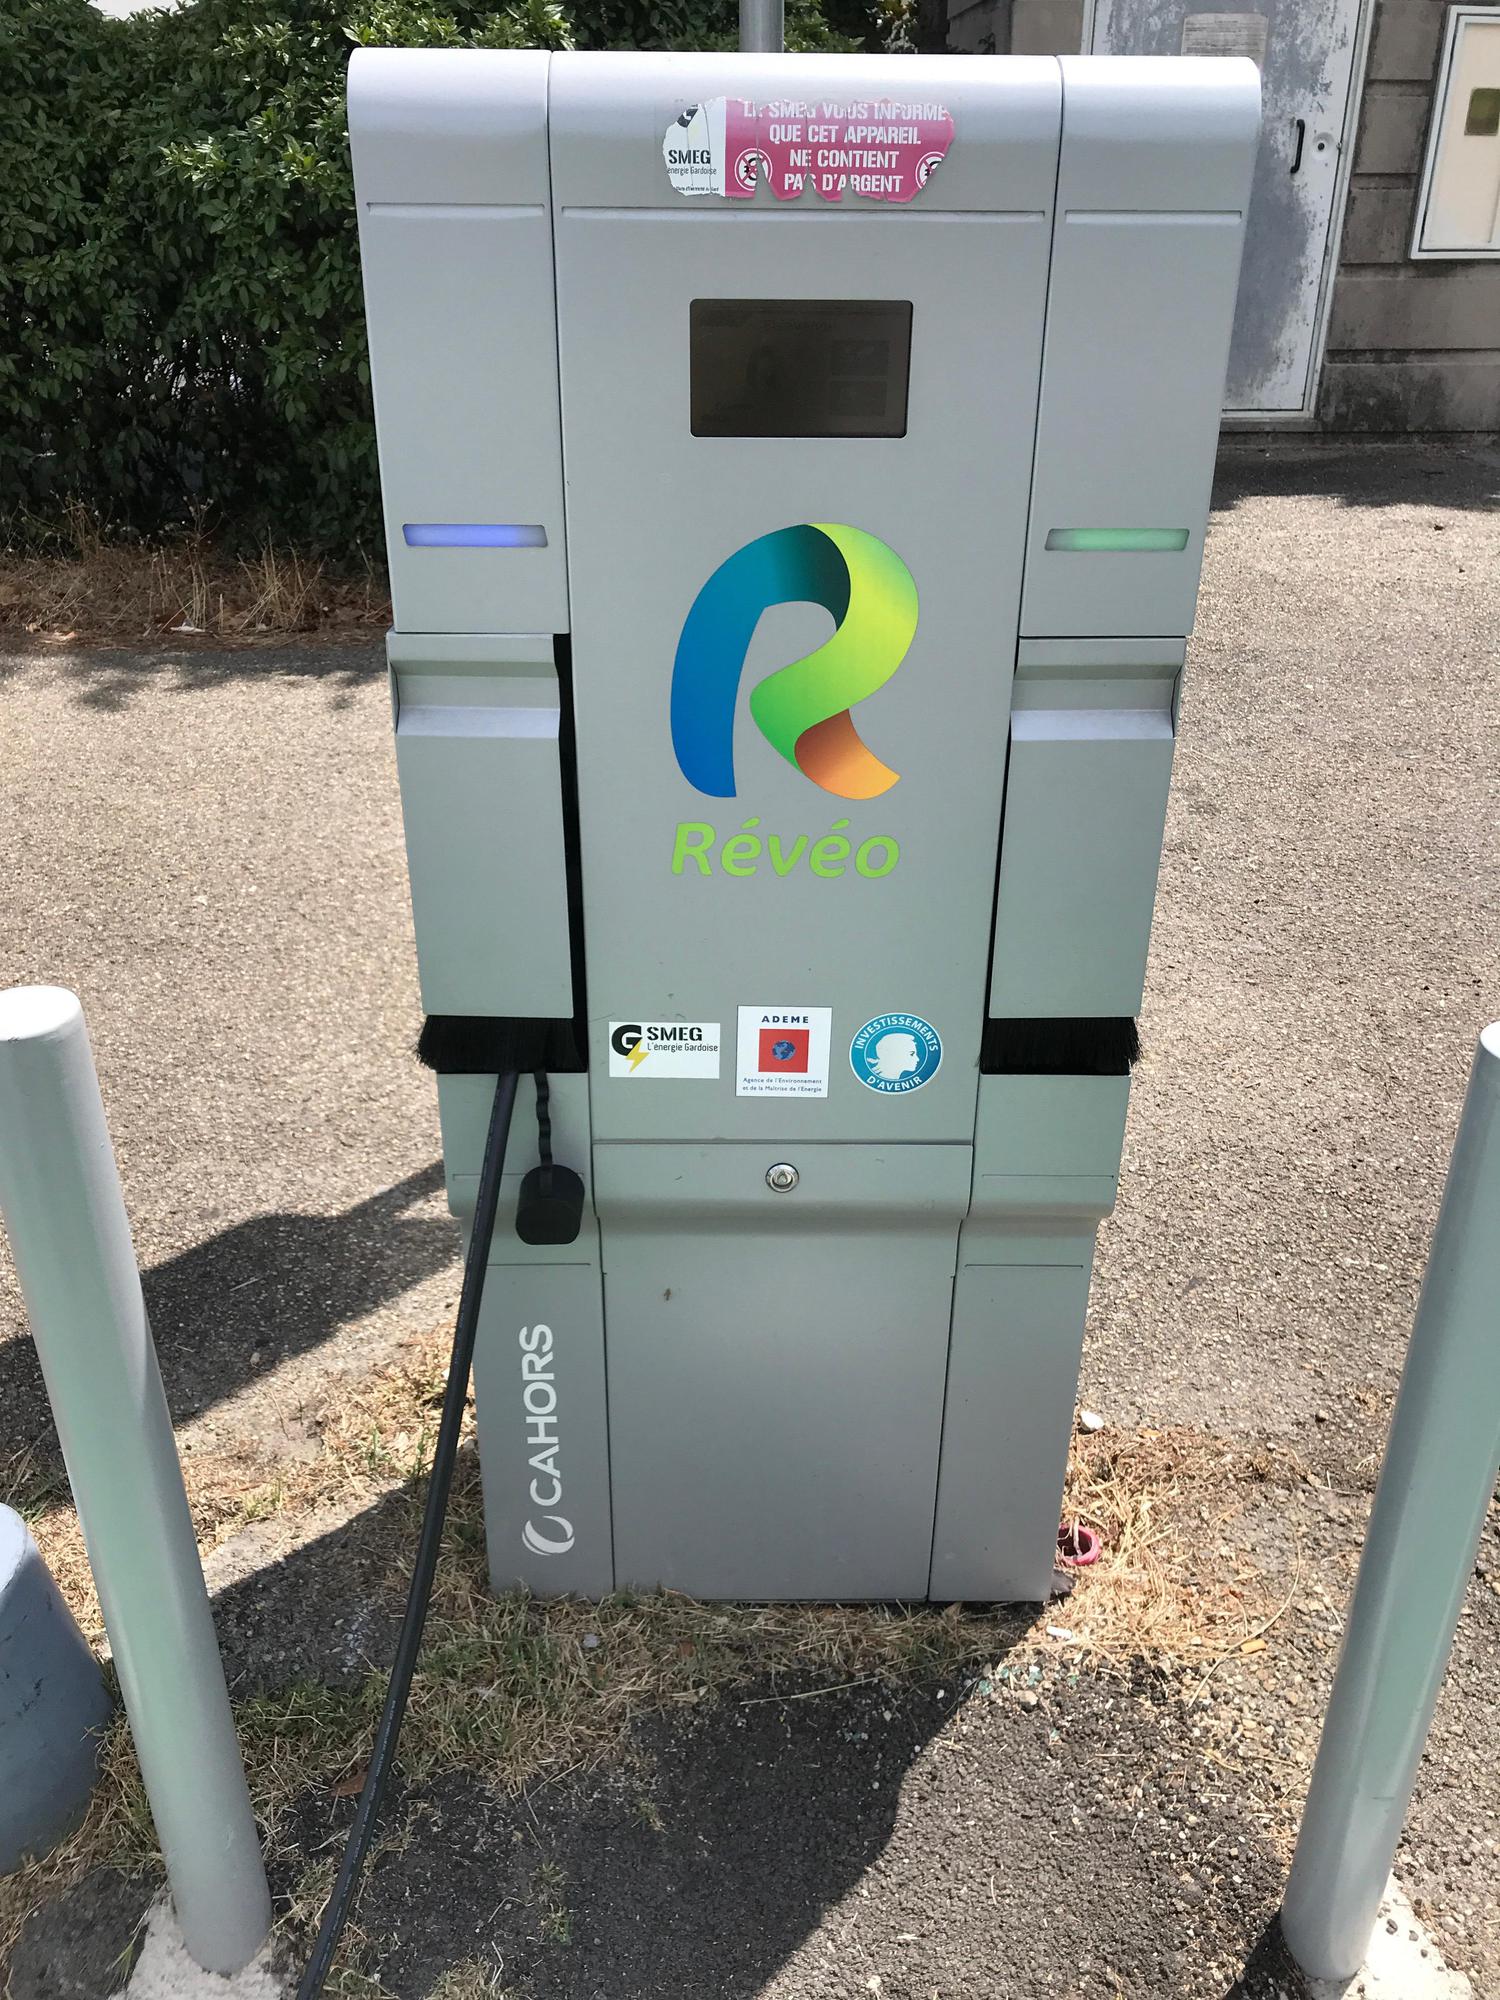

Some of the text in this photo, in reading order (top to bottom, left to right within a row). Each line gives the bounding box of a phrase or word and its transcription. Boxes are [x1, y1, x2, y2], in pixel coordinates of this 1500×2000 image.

[769, 124, 921, 144] QUE CET APPAREIL
[668, 149, 711, 164] SMEG
[789, 149, 900, 169] NE CONTIENT
[822, 174, 904, 192] D'ARGENT
[670, 817, 900, 878] Révéo
[761, 1015, 809, 1024] ADEME
[646, 1027, 702, 1041] SMEG
[855, 1016, 938, 1051] INVESTISSEMENTS
[684, 1043, 718, 1052] Gardoise
[866, 1075, 922, 1091] D'AVENIR
[519, 1324, 562, 1506] CAHORS
